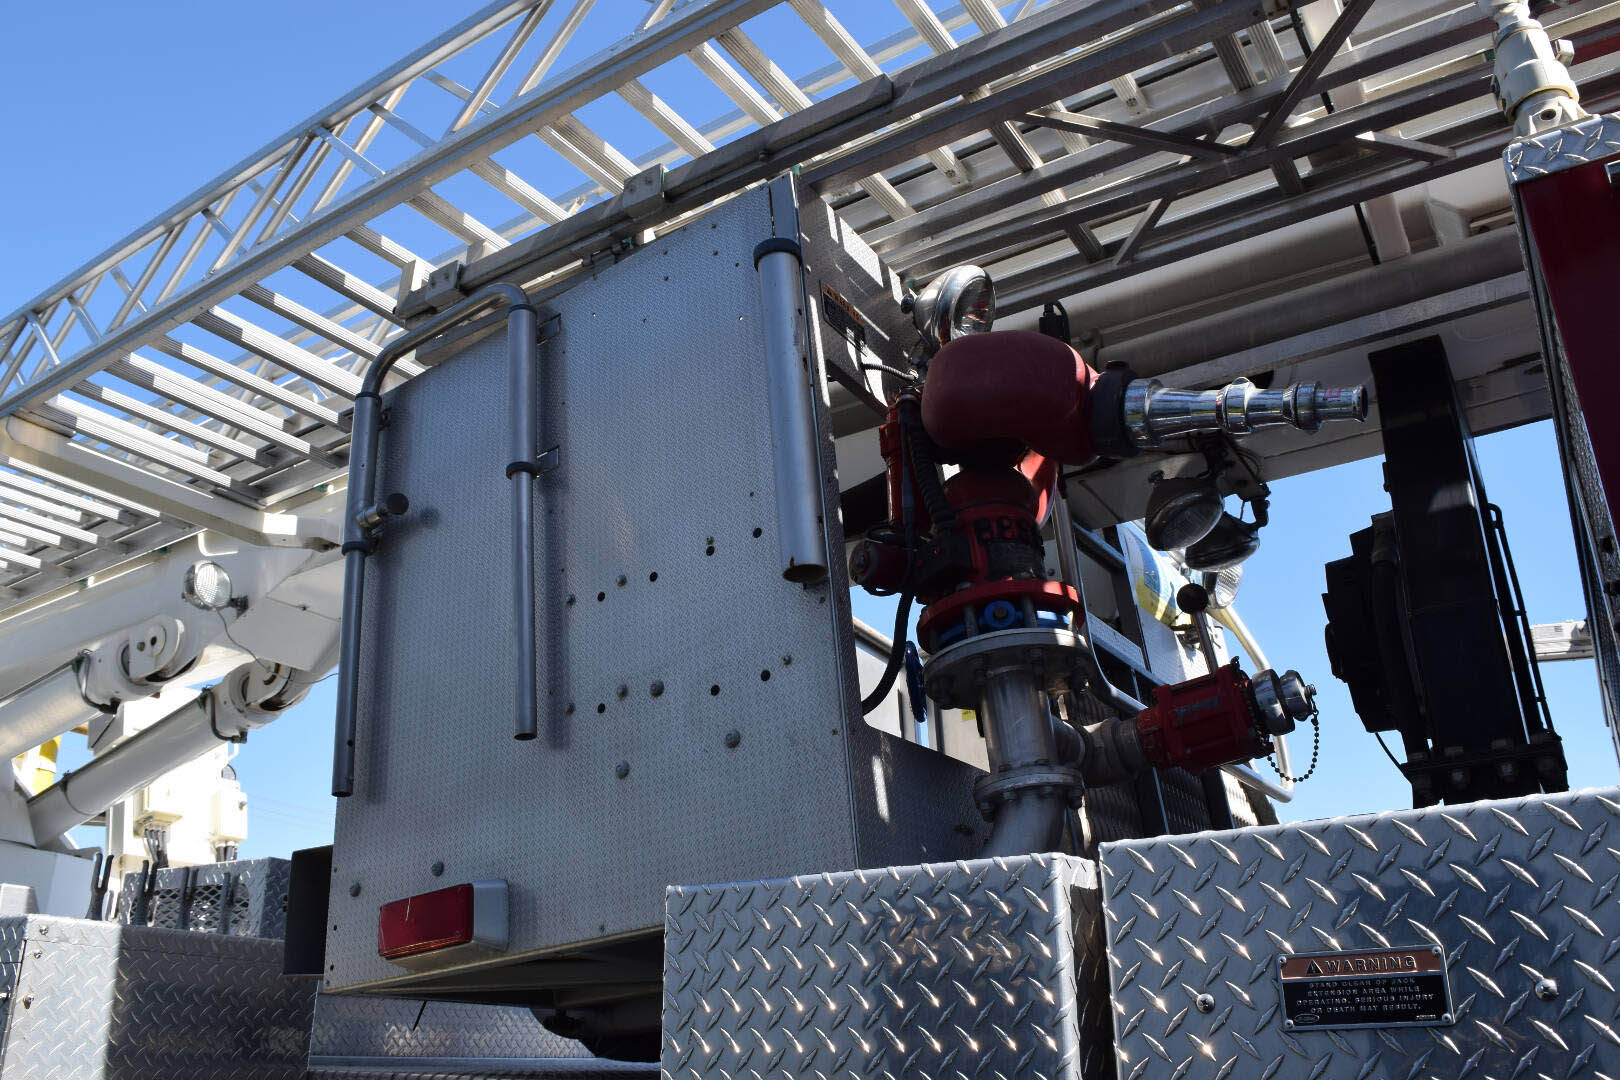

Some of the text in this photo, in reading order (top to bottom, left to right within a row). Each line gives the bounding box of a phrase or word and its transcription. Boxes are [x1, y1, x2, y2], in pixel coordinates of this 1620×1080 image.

[1325, 955, 1416, 973] WARNING
[1307, 985, 1420, 997] EXTENSION AREA WHILE
[1355, 994, 1395, 1003] SERIOUS
[1399, 993, 1434, 1002] INJURY
[1310, 1006, 1322, 1014] OR
[1326, 1005, 1355, 1013] DEATH
[1359, 1004, 1377, 1012] MAY
